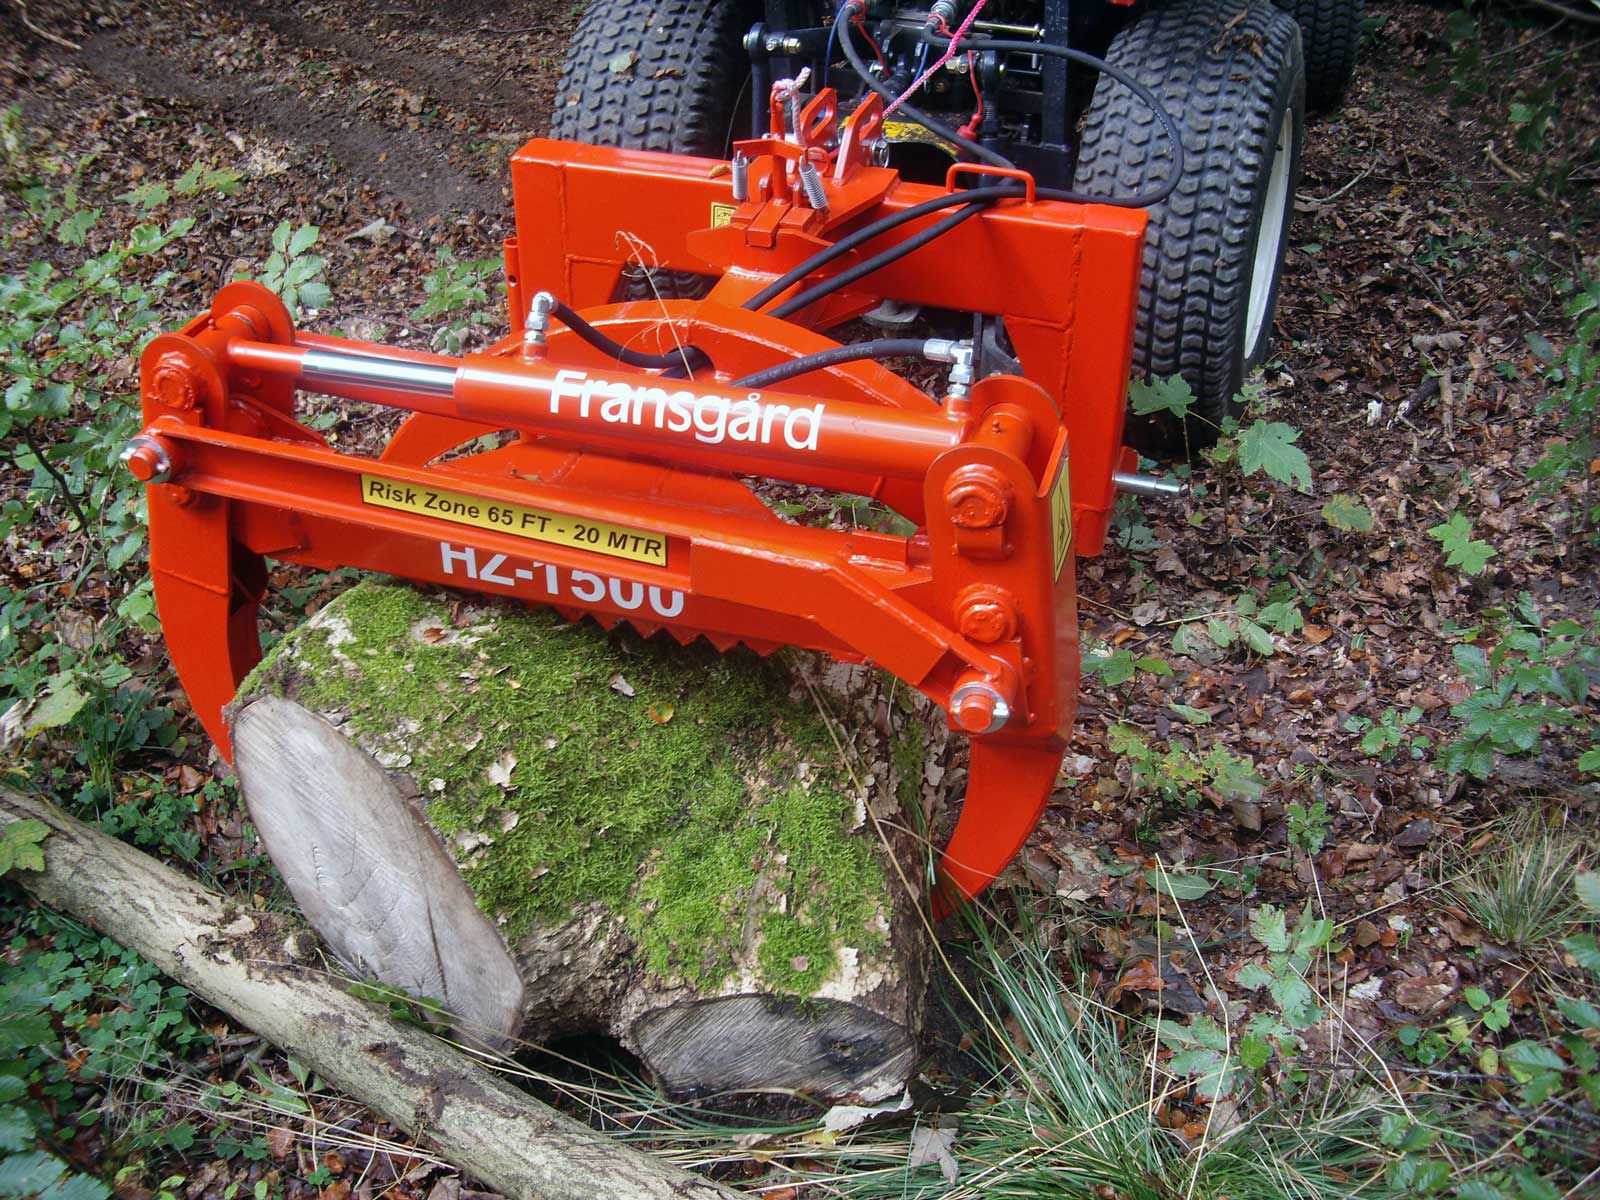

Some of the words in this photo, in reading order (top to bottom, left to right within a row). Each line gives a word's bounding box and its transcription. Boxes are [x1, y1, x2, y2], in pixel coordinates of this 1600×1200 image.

[549, 369, 825, 451] Fransgård
[369, 480, 416, 505] Risk
[424, 492, 480, 518] Zone
[487, 506, 513, 525] 65
[521, 512, 552, 533] FT
[573, 524, 600, 544] 20
[607, 531, 662, 557] MTR
[440, 541, 685, 618] HZ-1500
